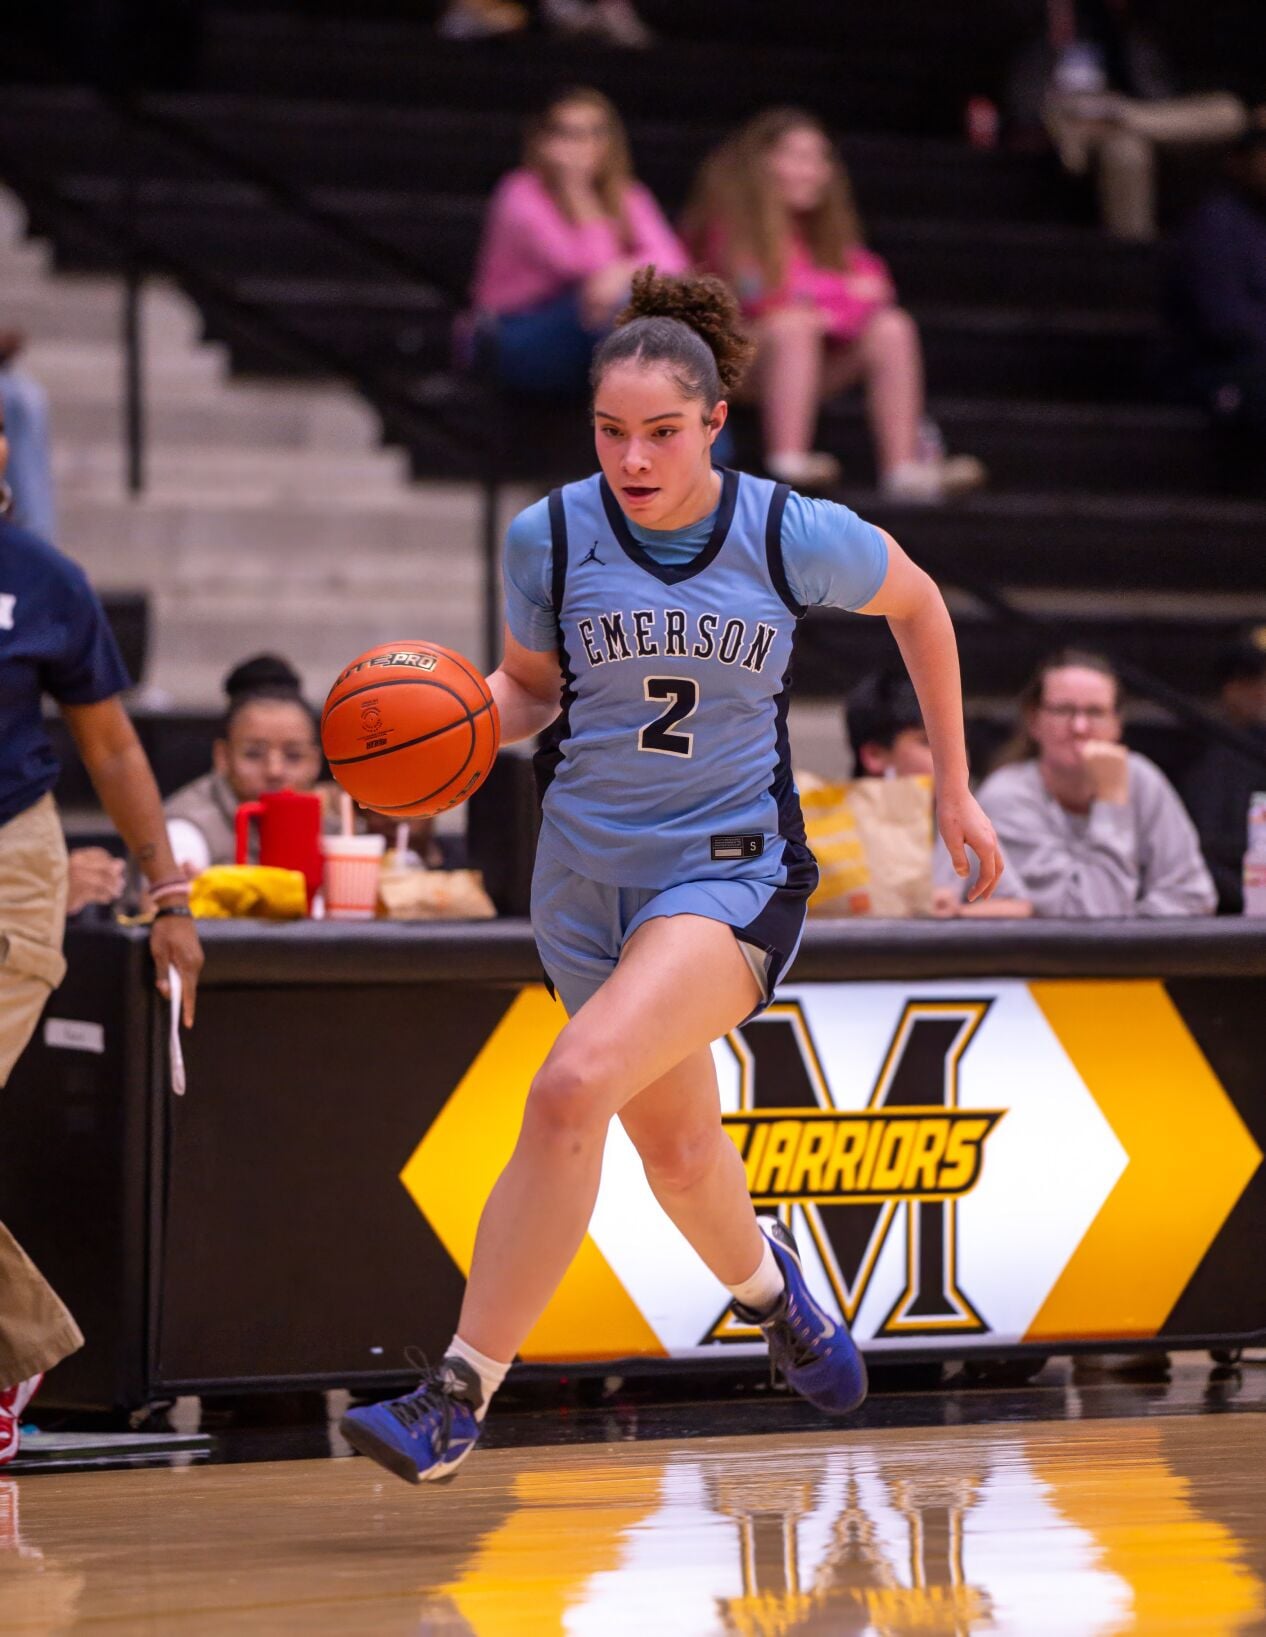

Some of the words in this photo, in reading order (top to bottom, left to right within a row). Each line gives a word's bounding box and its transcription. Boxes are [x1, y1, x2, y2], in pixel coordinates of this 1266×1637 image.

[391, 652, 435, 670] PRO
[577, 609, 778, 673] EMERSON
[637, 675, 700, 759] 2
[749, 841, 757, 852] S
[698, 996, 998, 1345] M
